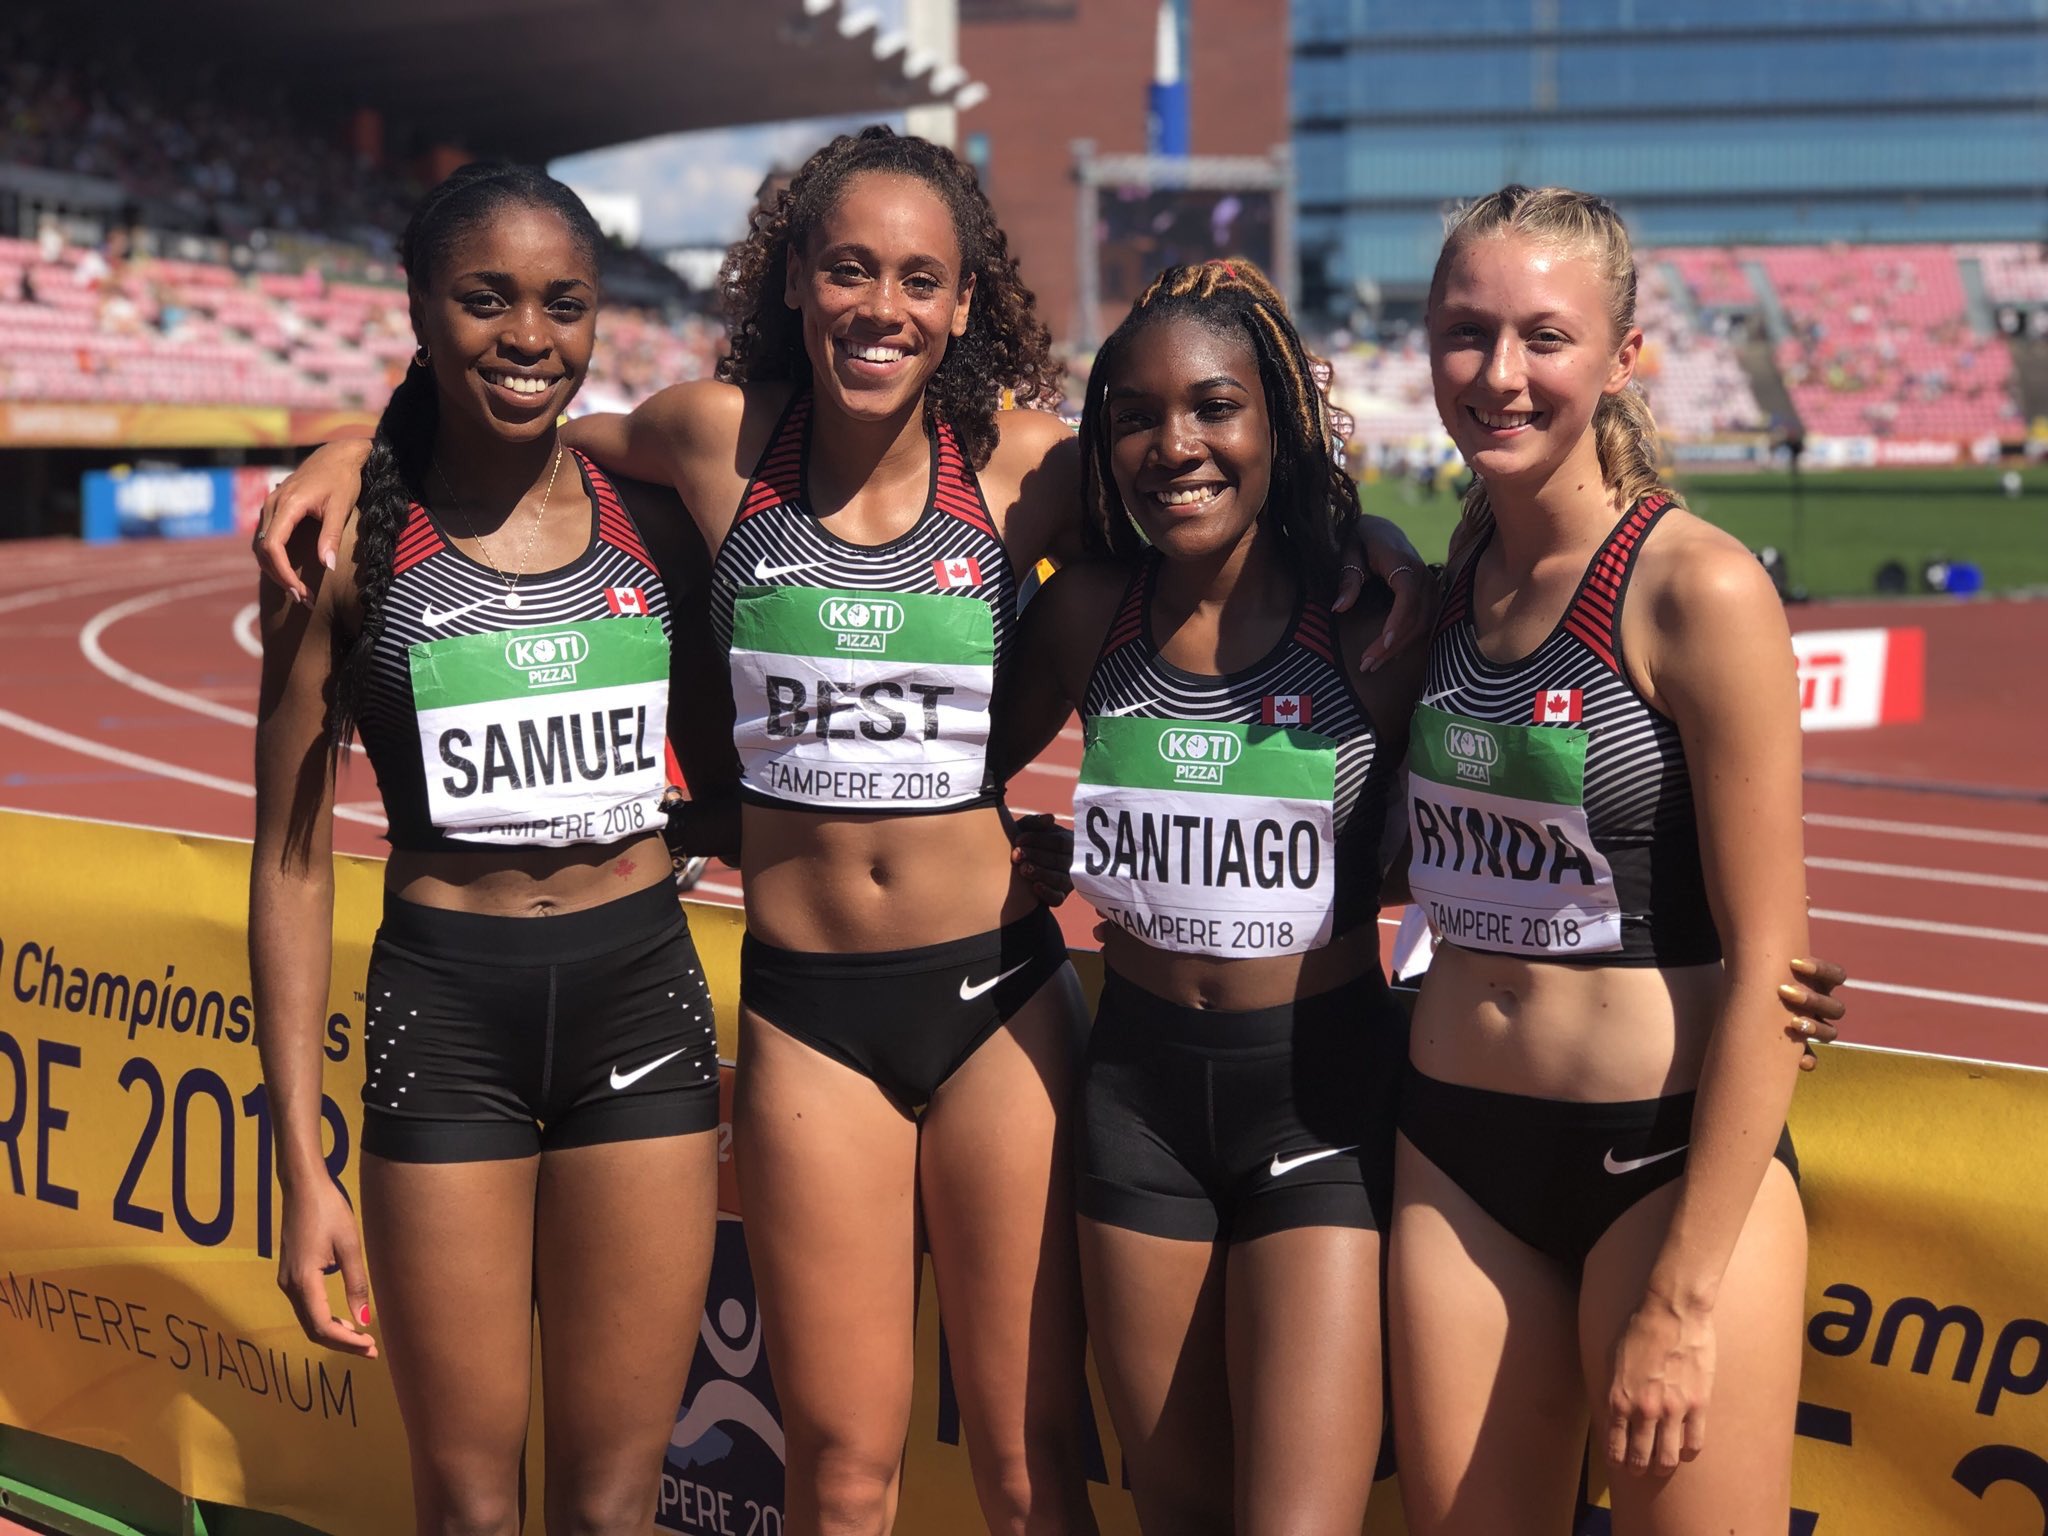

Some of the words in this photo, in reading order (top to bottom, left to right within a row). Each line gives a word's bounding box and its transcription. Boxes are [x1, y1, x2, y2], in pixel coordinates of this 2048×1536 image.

[829, 601, 894, 629] KOTI
[515, 635, 580, 666] KOTI
[837, 632, 881, 648] PIZZA
[528, 666, 572, 684] PIZZA
[765, 675, 955, 741] BEST
[438, 705, 656, 799] SAMUEL
[1168, 732, 1232, 761] KOTI
[1450, 727, 1493, 761] KOTI
[768, 760, 882, 799] TAMPERE
[891, 771, 951, 799] 2018
[1176, 764, 1219, 780] PIZZA
[1457, 761, 1487, 780] PIZZA
[478, 812, 595, 839] AMPERE
[603, 802, 645, 836] 2018
[1085, 805, 1320, 890] SANTIAGO
[1413, 796, 1597, 886] RYNDA
[1108, 906, 1222, 947] TAMPERE
[1231, 921, 1294, 949] 2018
[1430, 901, 1513, 944] TAMPERE
[1521, 916, 1581, 948] 2018
[14, 940, 351, 1062] Championss
[165, 1313, 357, 1427] STADIUM
[656, 1472, 736, 1536] PERE
[744, 1500, 785, 1536] 20
